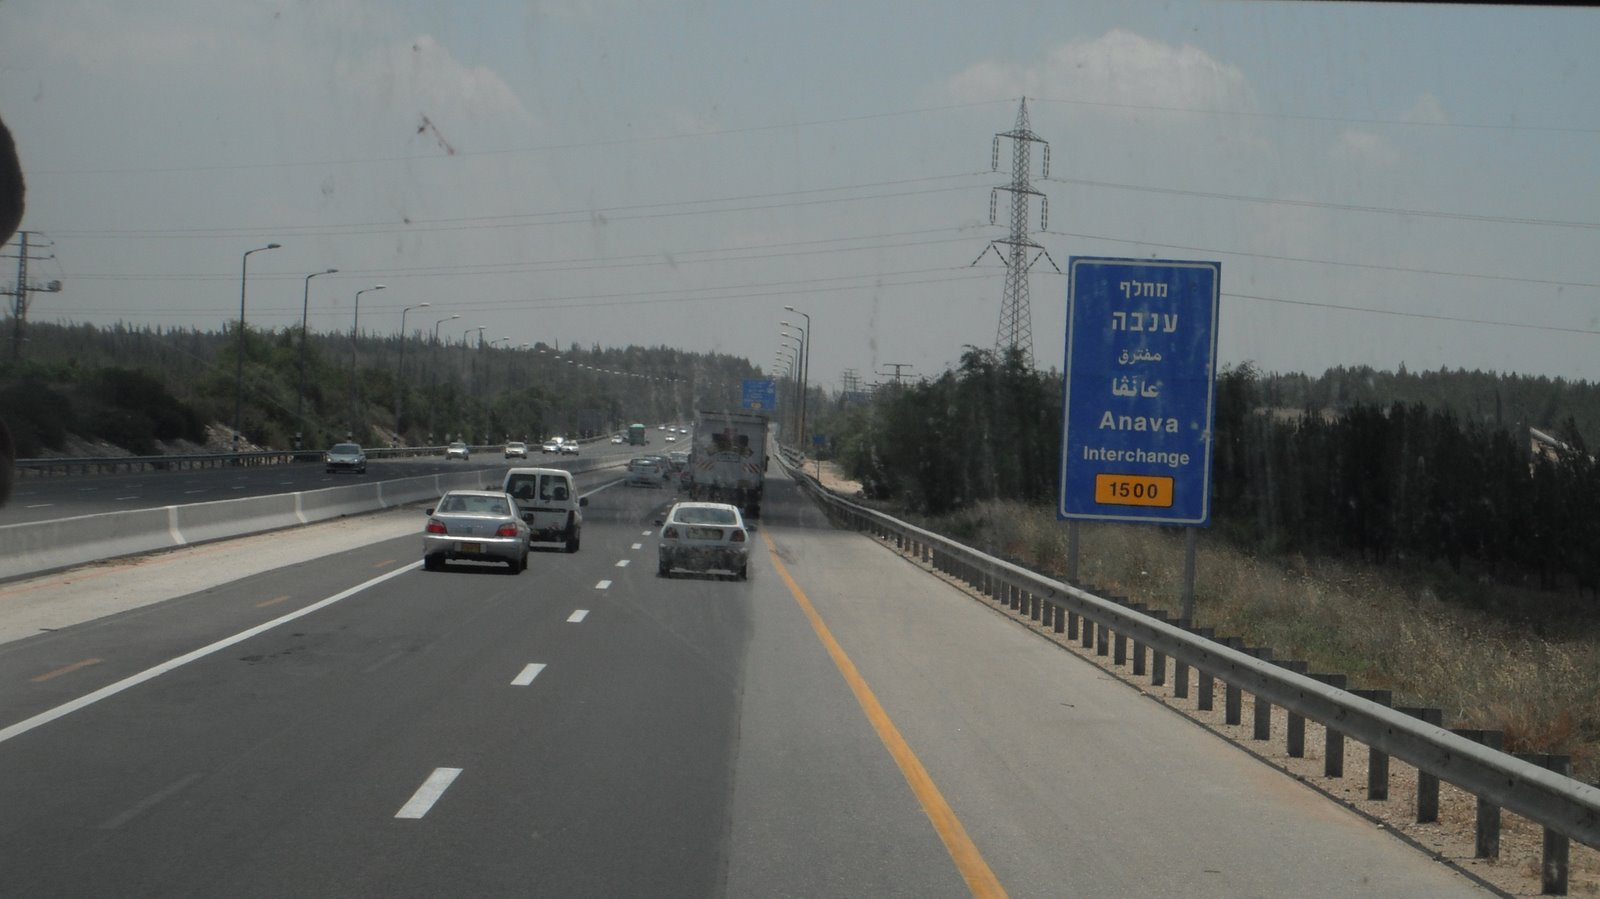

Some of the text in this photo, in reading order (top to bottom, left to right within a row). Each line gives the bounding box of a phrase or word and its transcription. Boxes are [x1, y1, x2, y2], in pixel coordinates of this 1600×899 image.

[1120, 280, 1168, 299] מחלף
[1111, 311, 1178, 333] ענבה
[1118, 348, 1162, 365] مفترق
[1099, 411, 1179, 433] Anava
[1083, 446, 1190, 468] Interchange
[1109, 482, 1158, 499] 1500
